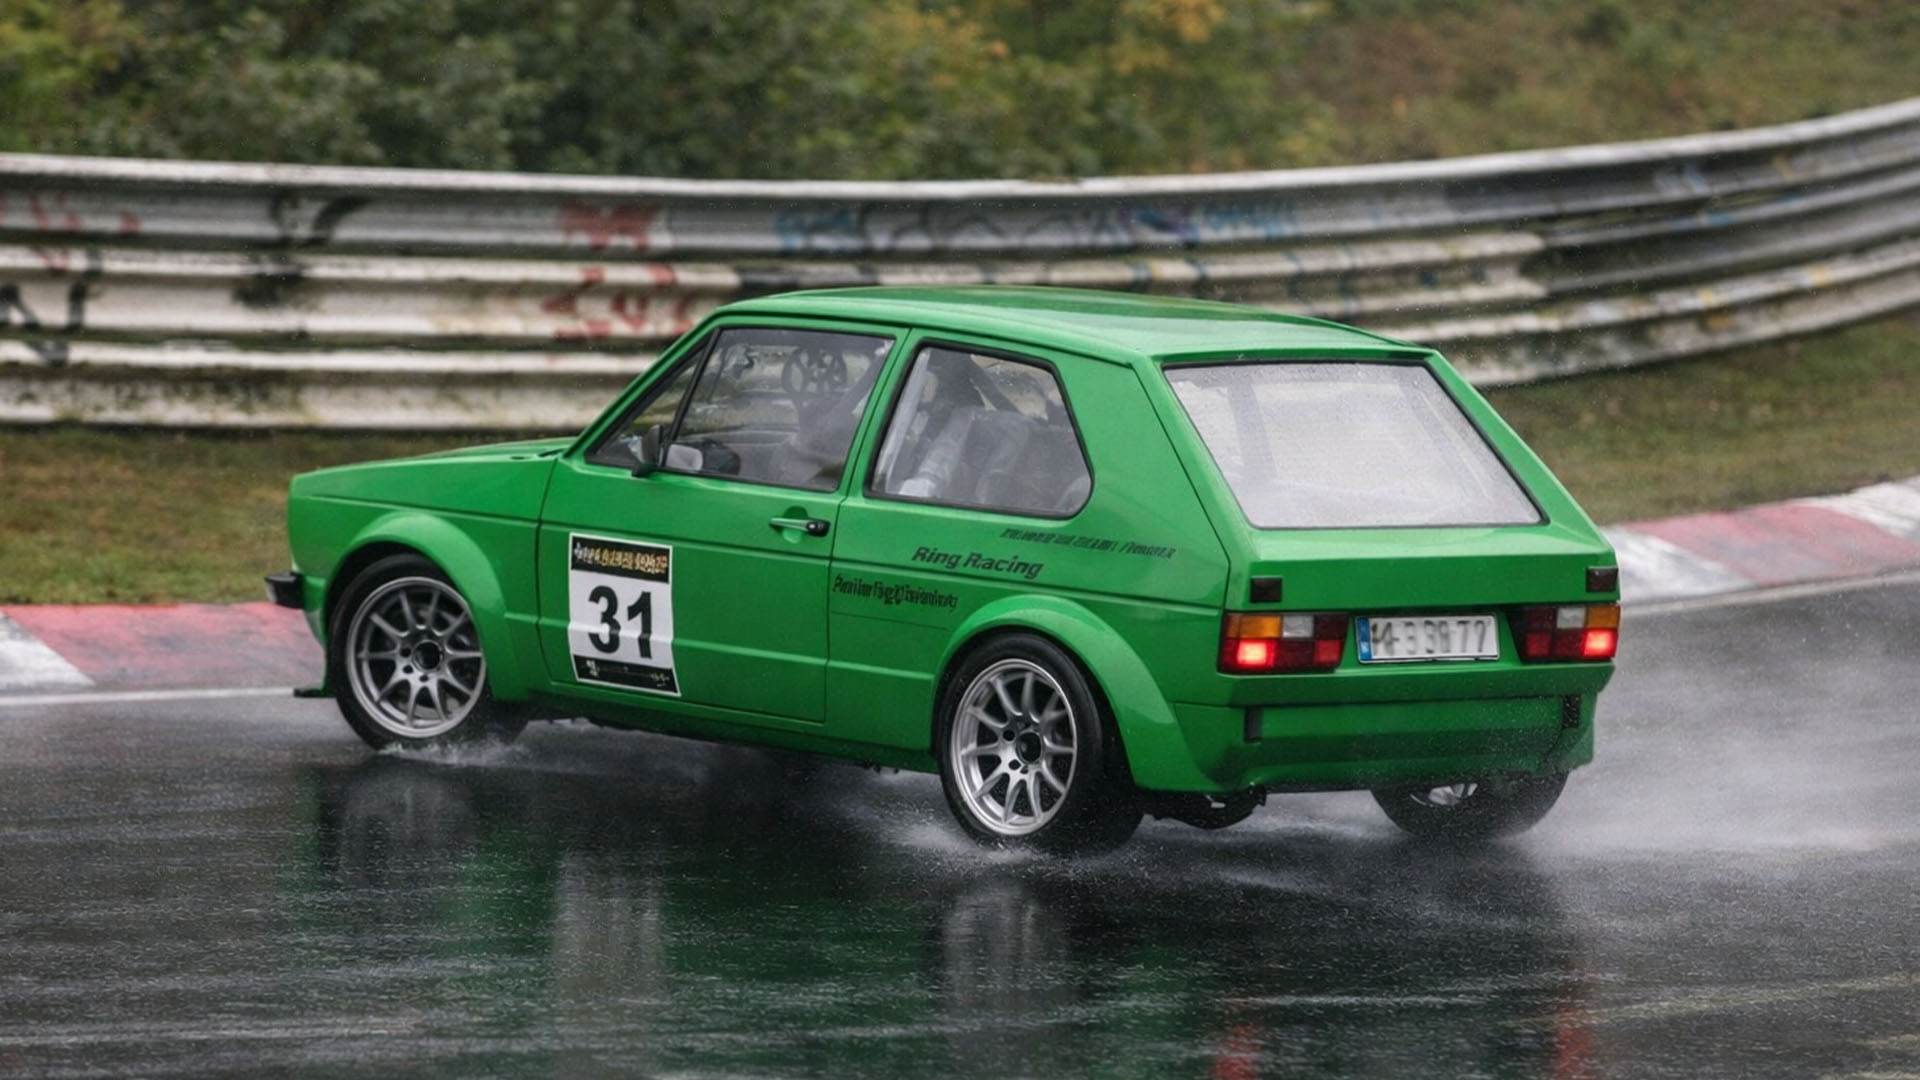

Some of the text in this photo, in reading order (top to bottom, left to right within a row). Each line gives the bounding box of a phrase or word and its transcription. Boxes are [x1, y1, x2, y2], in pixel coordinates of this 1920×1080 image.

[912, 546, 1044, 580] Ring Racing
[588, 585, 652, 659] 31
